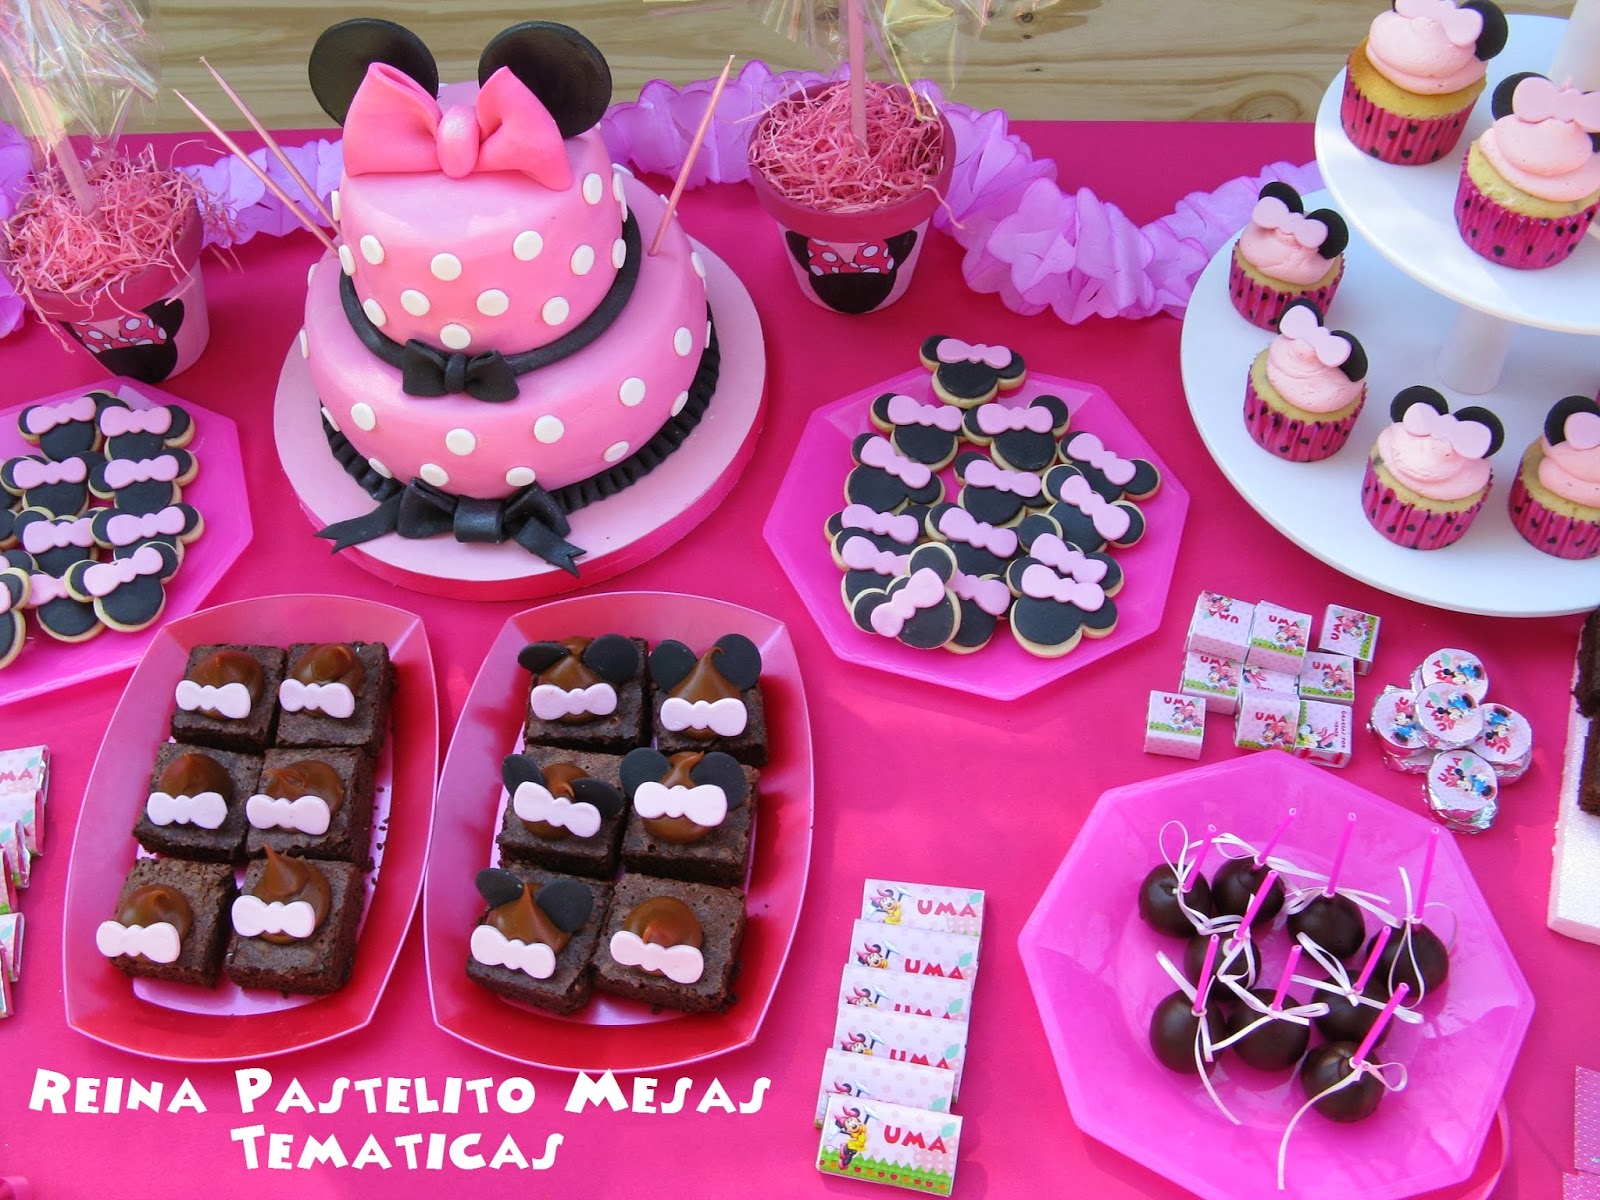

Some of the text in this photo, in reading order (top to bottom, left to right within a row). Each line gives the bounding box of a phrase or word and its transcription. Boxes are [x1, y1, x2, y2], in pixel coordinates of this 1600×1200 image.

[1209, 609, 1239, 624] UMA
[1268, 615, 1299, 628] UMA
[1331, 615, 1344, 640] UMA
[1200, 656, 1231, 668] UMA
[1312, 661, 1344, 672] UMA
[1164, 697, 1195, 707] UMA
[1255, 712, 1287, 723] UMA
[0, 768, 33, 784] MA
[1437, 757, 1462, 783] UMA
[917, 899, 977, 918] UMA
[904, 958, 965, 980] UMA
[883, 1124, 947, 1154] UMA
